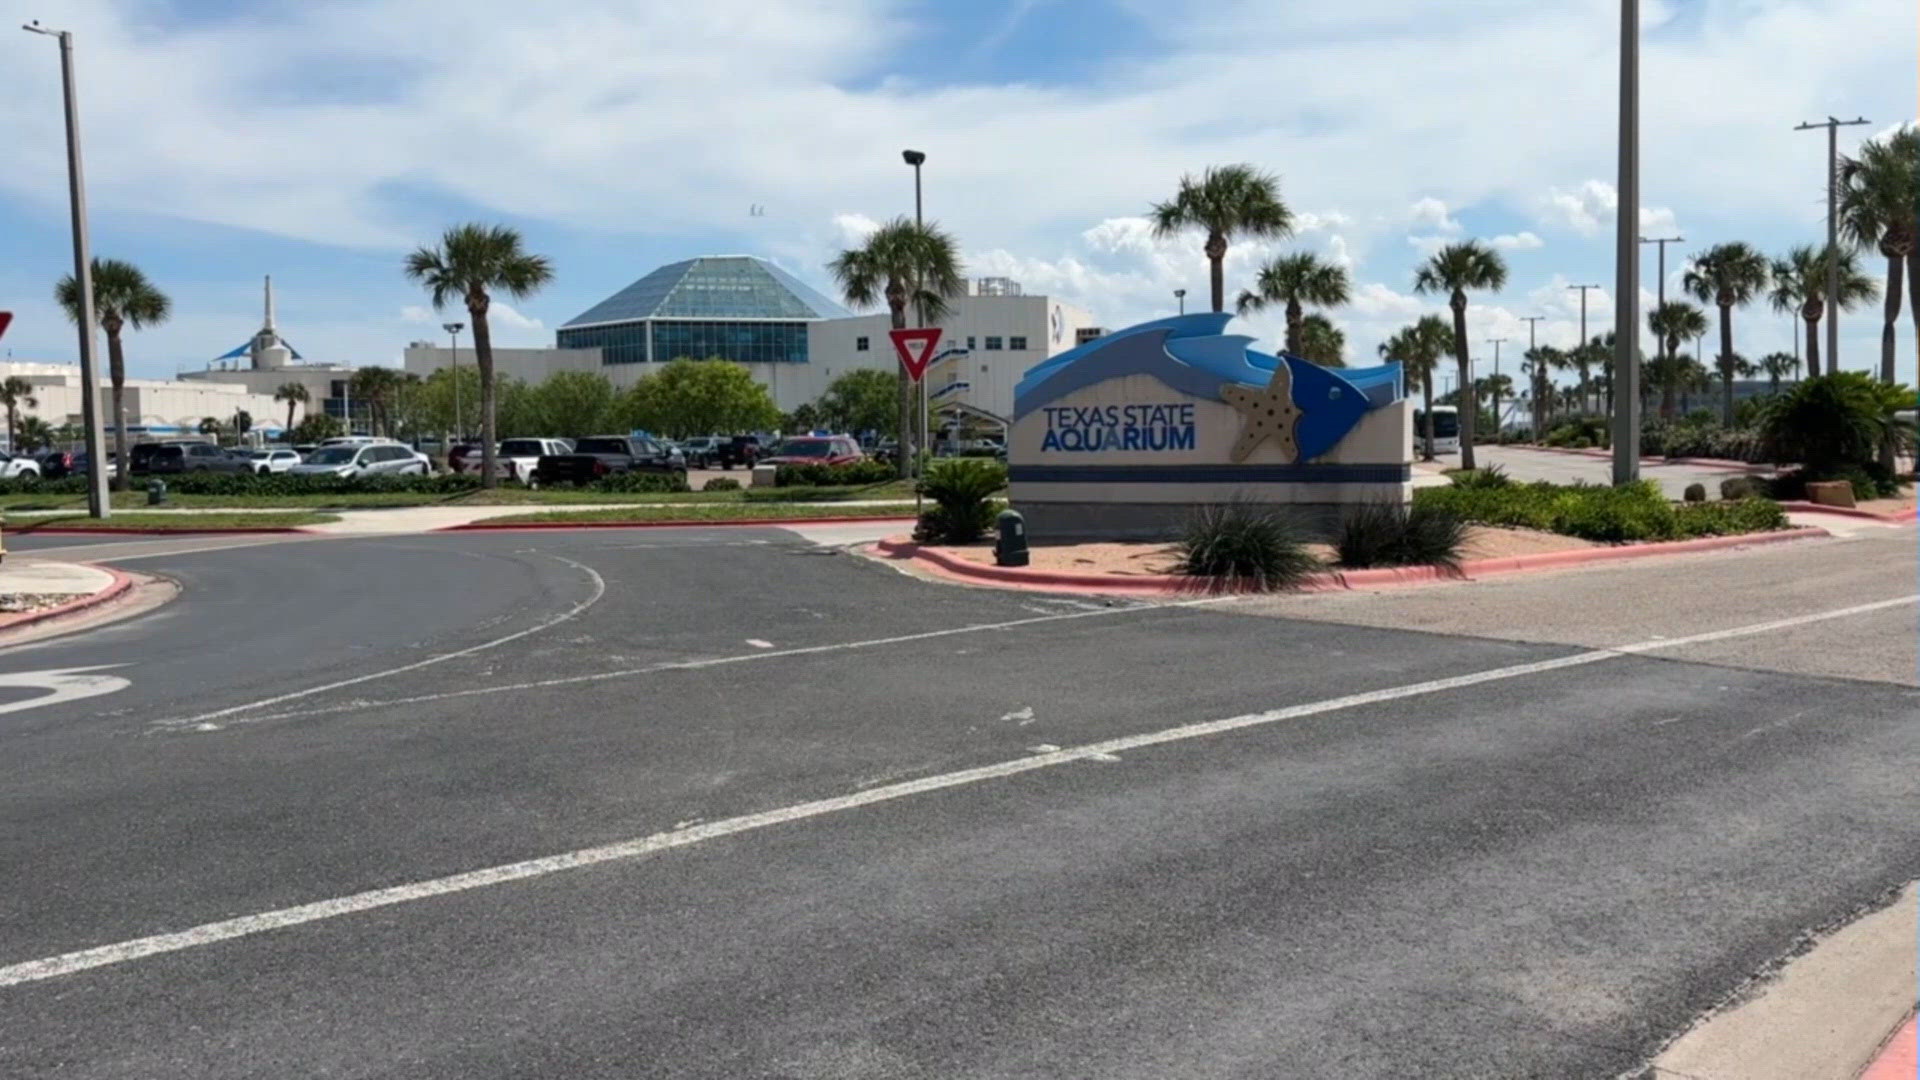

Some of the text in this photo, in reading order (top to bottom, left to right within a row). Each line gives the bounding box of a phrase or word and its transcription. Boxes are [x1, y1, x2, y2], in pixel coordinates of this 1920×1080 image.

[1043, 404, 1195, 428] TEXAS STATE
[1041, 426, 1196, 451] AQUARIUM
